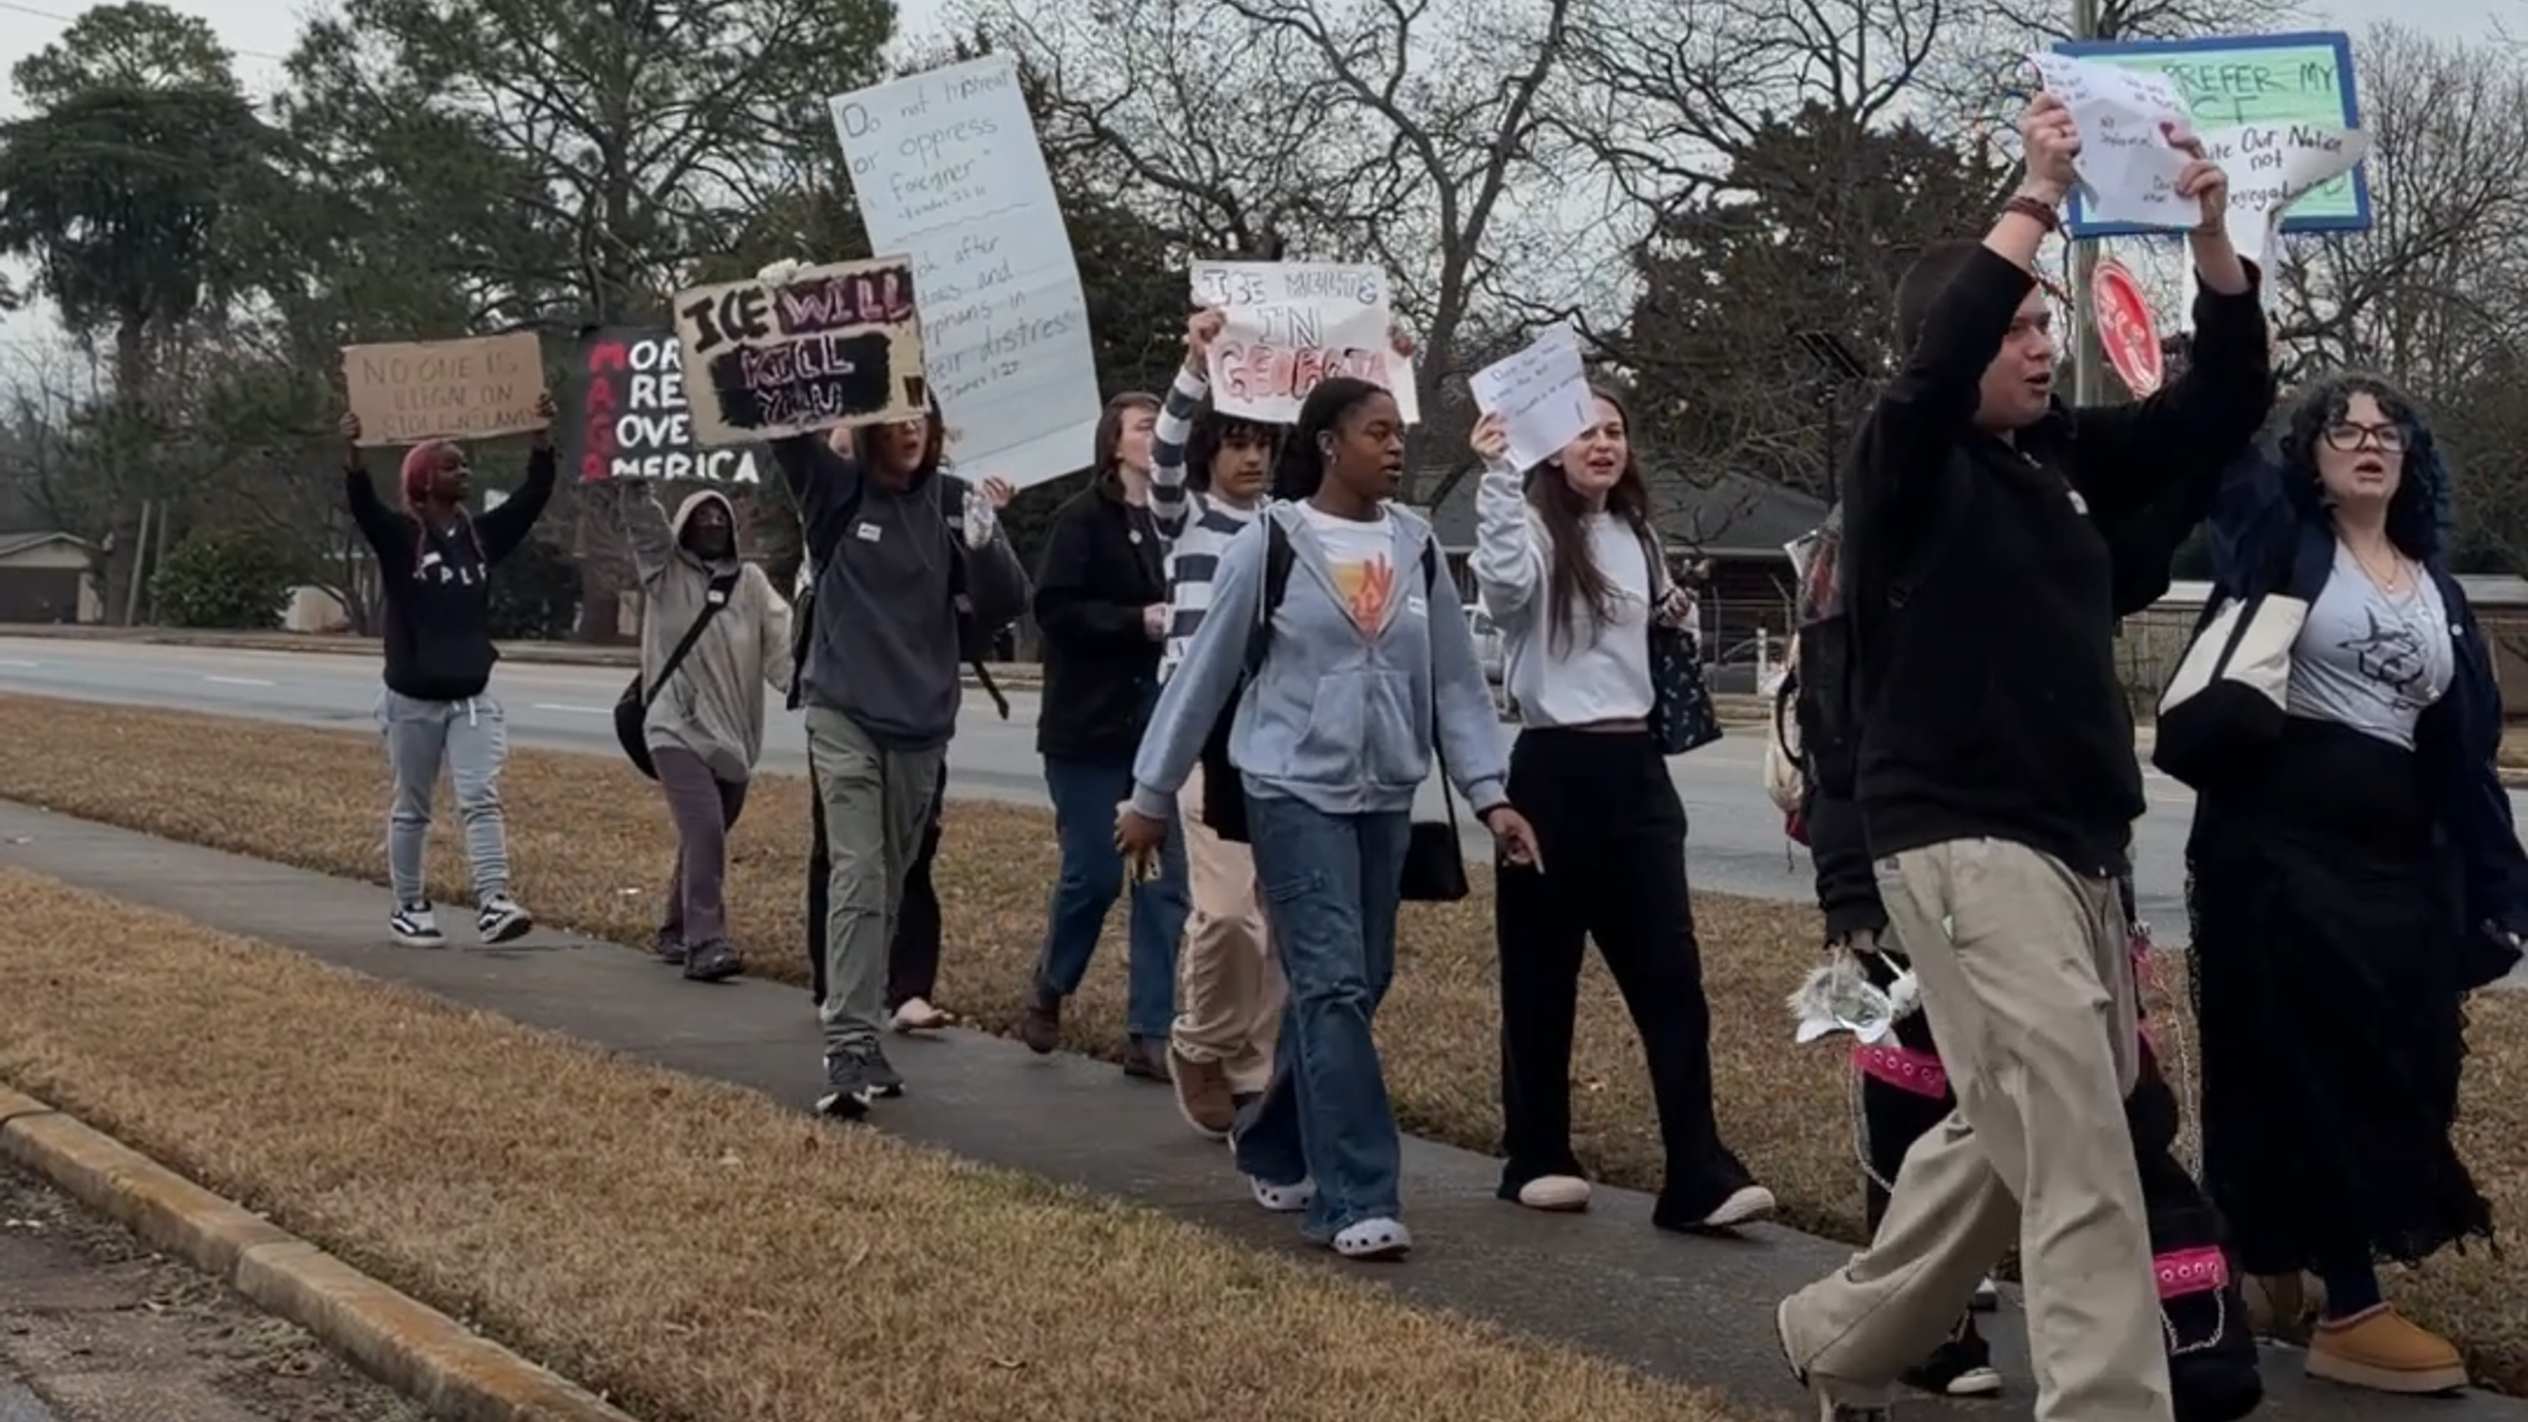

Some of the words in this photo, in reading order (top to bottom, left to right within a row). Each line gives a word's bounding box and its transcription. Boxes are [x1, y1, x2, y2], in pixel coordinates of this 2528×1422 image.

[2299, 61, 2334, 94] MY
[842, 102, 881, 138] Do
[900, 84, 930, 118] not
[854, 151, 878, 174] or
[900, 117, 998, 167] oppress
[2241, 127, 2277, 153] Our
[2251, 149, 2283, 170] not
[955, 235, 1000, 266] after
[977, 257, 1014, 290] and
[682, 286, 770, 354] ICE
[779, 273, 912, 325] WILL
[924, 301, 992, 347] rphans
[1009, 291, 1026, 309] in
[1258, 306, 1323, 350] IN
[363, 357, 409, 385] NO
[418, 355, 472, 383] ONE
[486, 352, 519, 374] IS
[741, 334, 854, 389] KILL
[481, 384, 514, 406] ON
